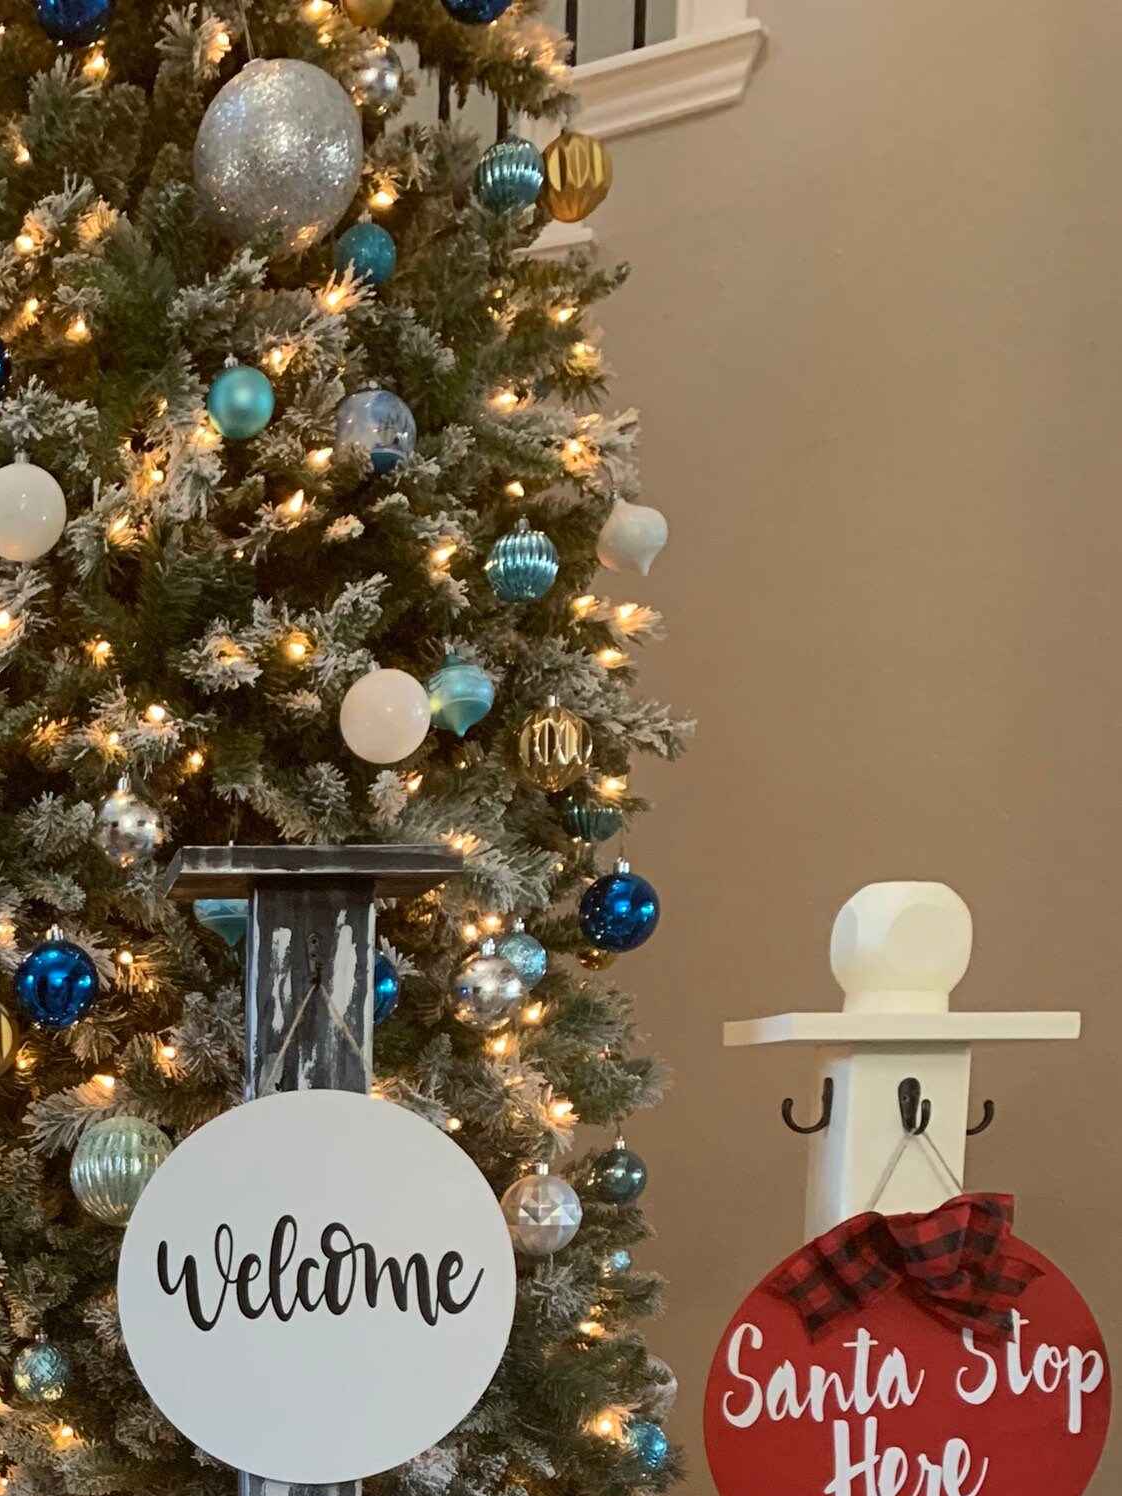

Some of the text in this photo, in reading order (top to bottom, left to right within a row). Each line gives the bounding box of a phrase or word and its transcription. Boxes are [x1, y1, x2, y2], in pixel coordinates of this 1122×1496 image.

[156, 1214, 485, 1332] Welcome
[722, 1308, 1105, 1434] Santa Stop
